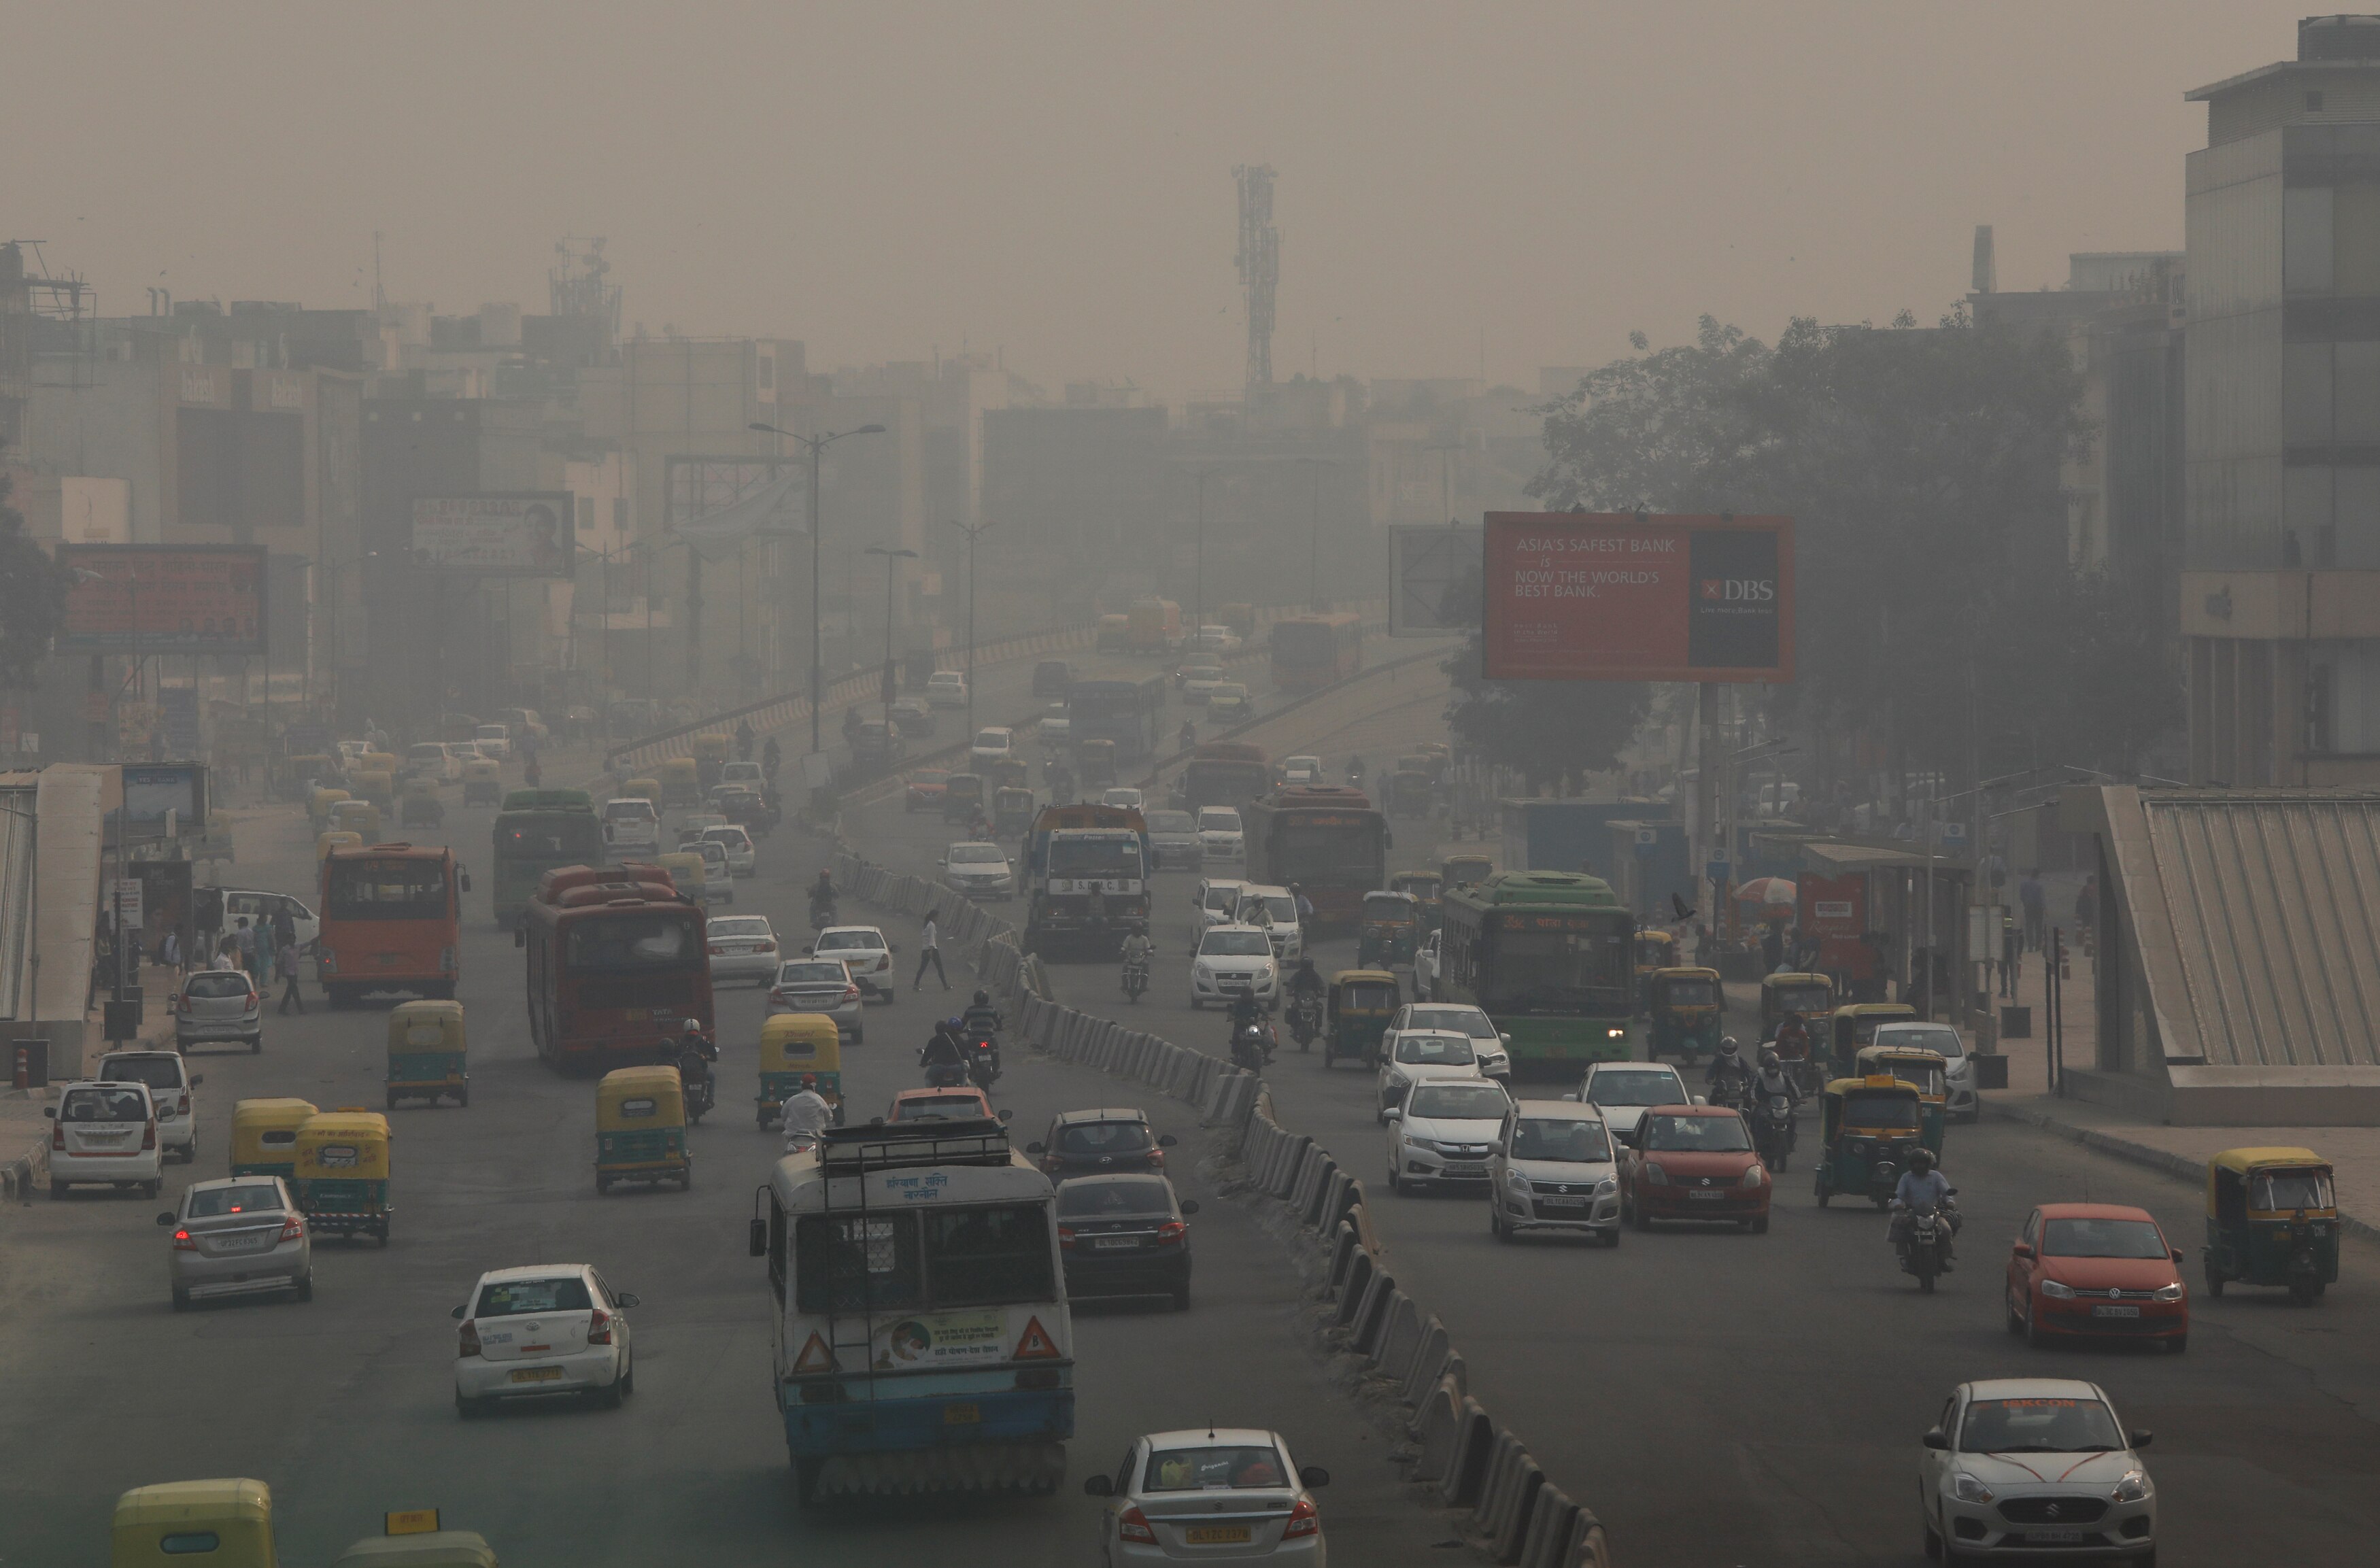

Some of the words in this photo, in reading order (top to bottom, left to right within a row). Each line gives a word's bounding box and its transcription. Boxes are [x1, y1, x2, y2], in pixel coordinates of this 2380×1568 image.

[1516, 539, 1565, 552] ASIA'S
[1569, 539, 1626, 553] SAFEST
[1630, 539, 1676, 553] BANK
[1540, 555, 1551, 568] is
[1515, 570, 1554, 583] NOW
[1559, 571, 1586, 583] THE
[1590, 571, 1659, 584] WORLD'S
[1515, 585, 1549, 598] BEST
[1554, 585, 1600, 598] BANK.
[1725, 579, 1774, 601] DBS
